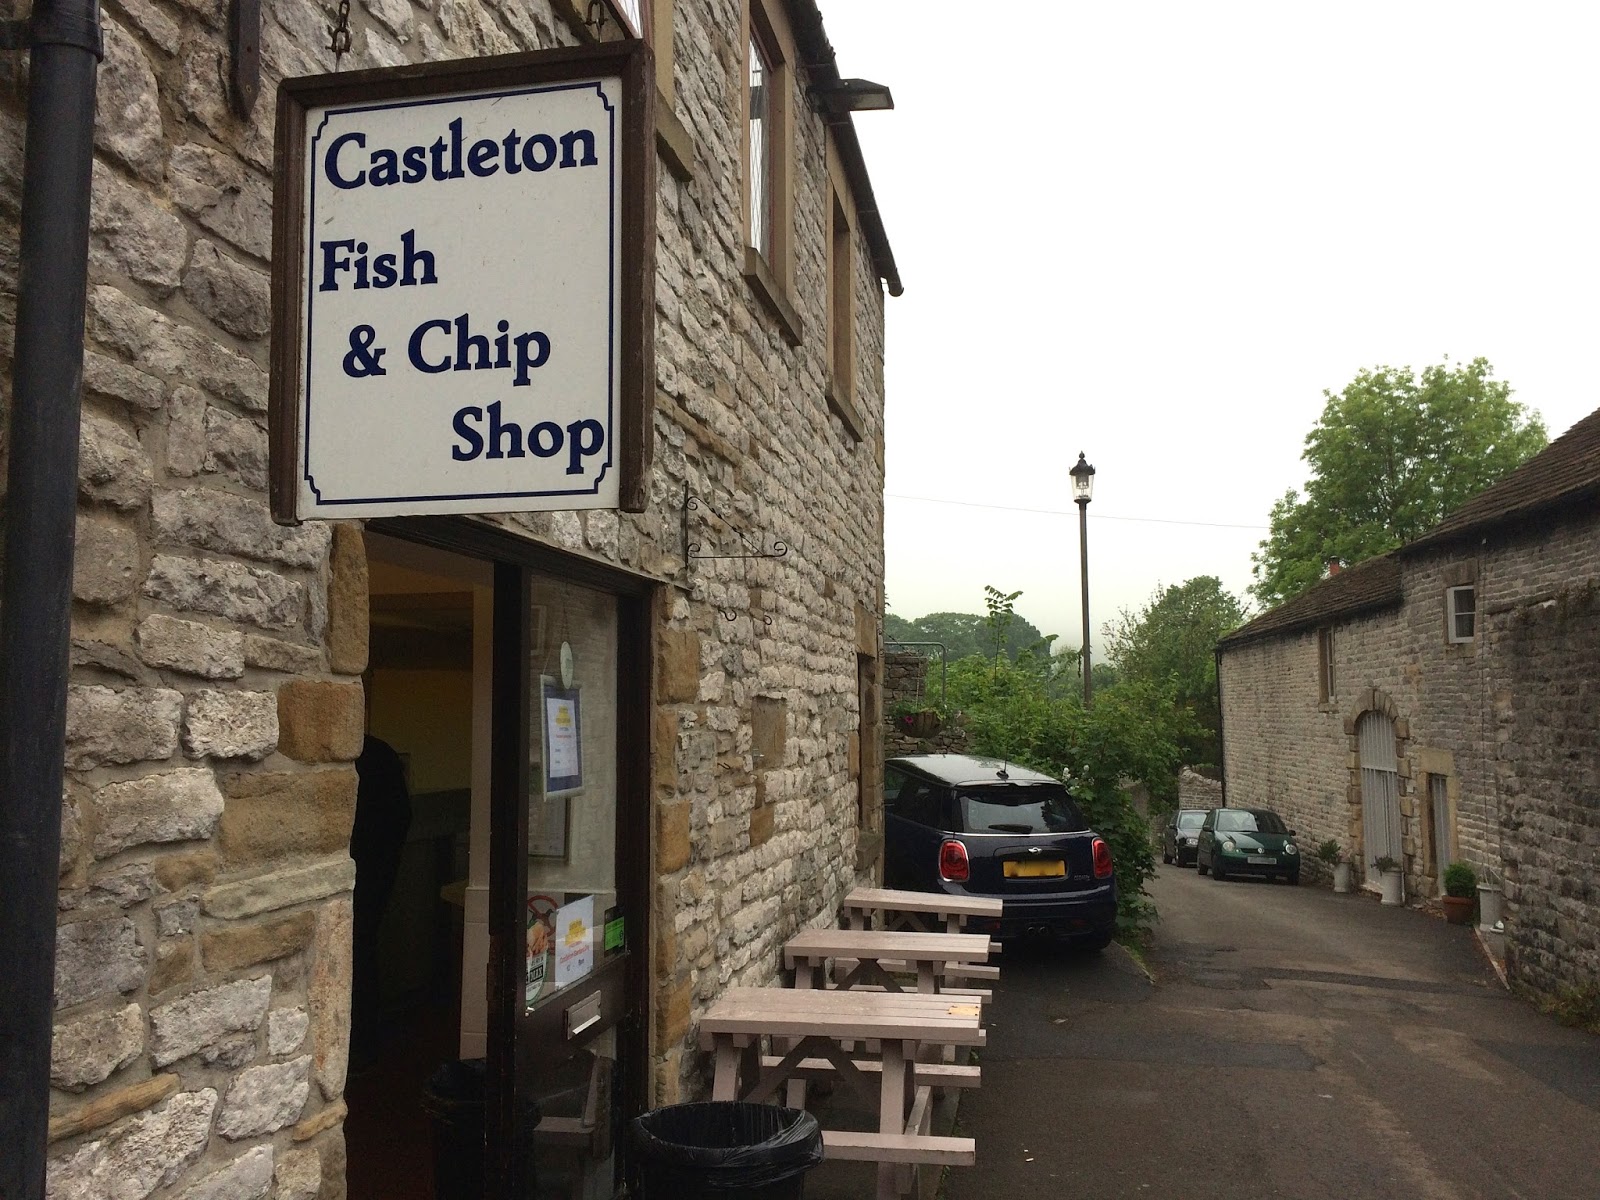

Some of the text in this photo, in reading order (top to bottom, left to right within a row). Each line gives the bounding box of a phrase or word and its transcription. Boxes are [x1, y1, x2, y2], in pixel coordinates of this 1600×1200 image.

[324, 117, 599, 189] Castleton
[319, 229, 438, 292] Fish
[342, 313, 551, 387] & Chip
[452, 400, 605, 475] Shop
